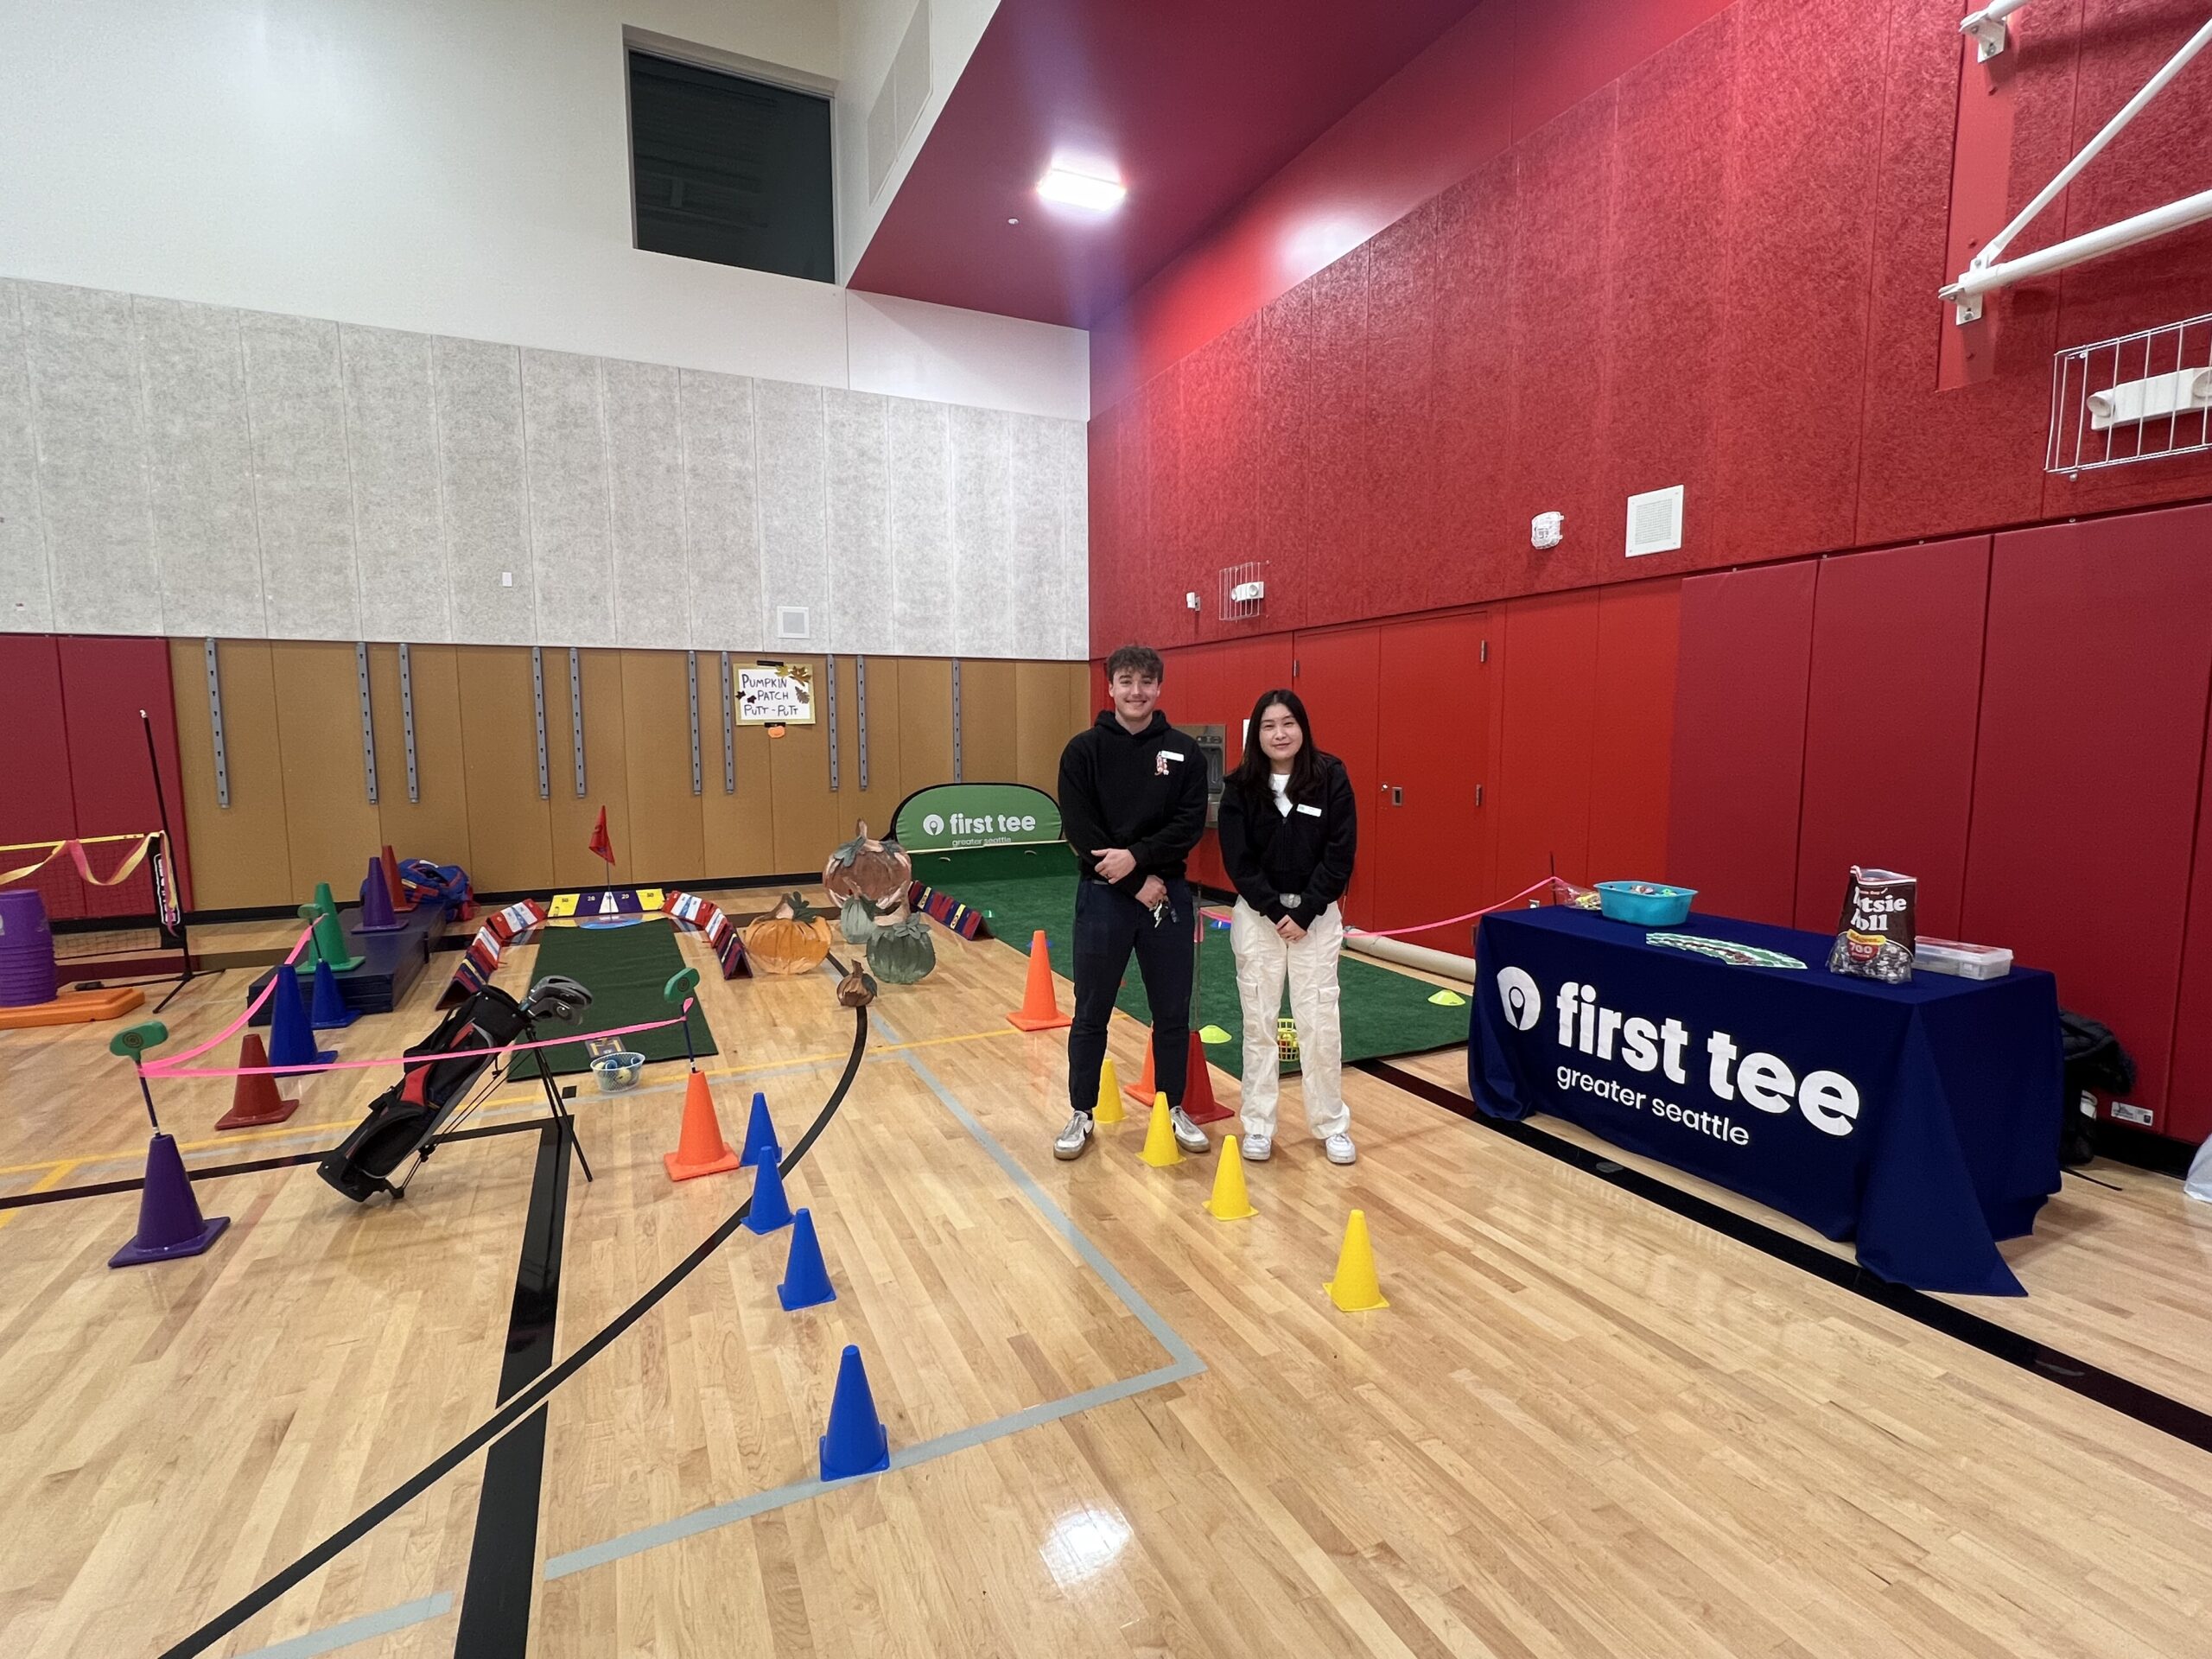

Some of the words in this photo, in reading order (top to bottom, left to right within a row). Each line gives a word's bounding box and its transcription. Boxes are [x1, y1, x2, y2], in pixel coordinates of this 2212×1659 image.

[742, 674, 787, 688] PUMPKIN
[758, 690, 789, 701] PATCH
[950, 813, 994, 835] first
[998, 814, 1036, 832] tee
[952, 837, 982, 848] greater
[1853, 887, 1907, 912] tsie
[1850, 942, 1872, 953] 700
[1557, 982, 1688, 1084] first
[1707, 1031, 1859, 1136] tee
[1557, 1065, 1646, 1110] greater
[1651, 1097, 1750, 1146] seattle
